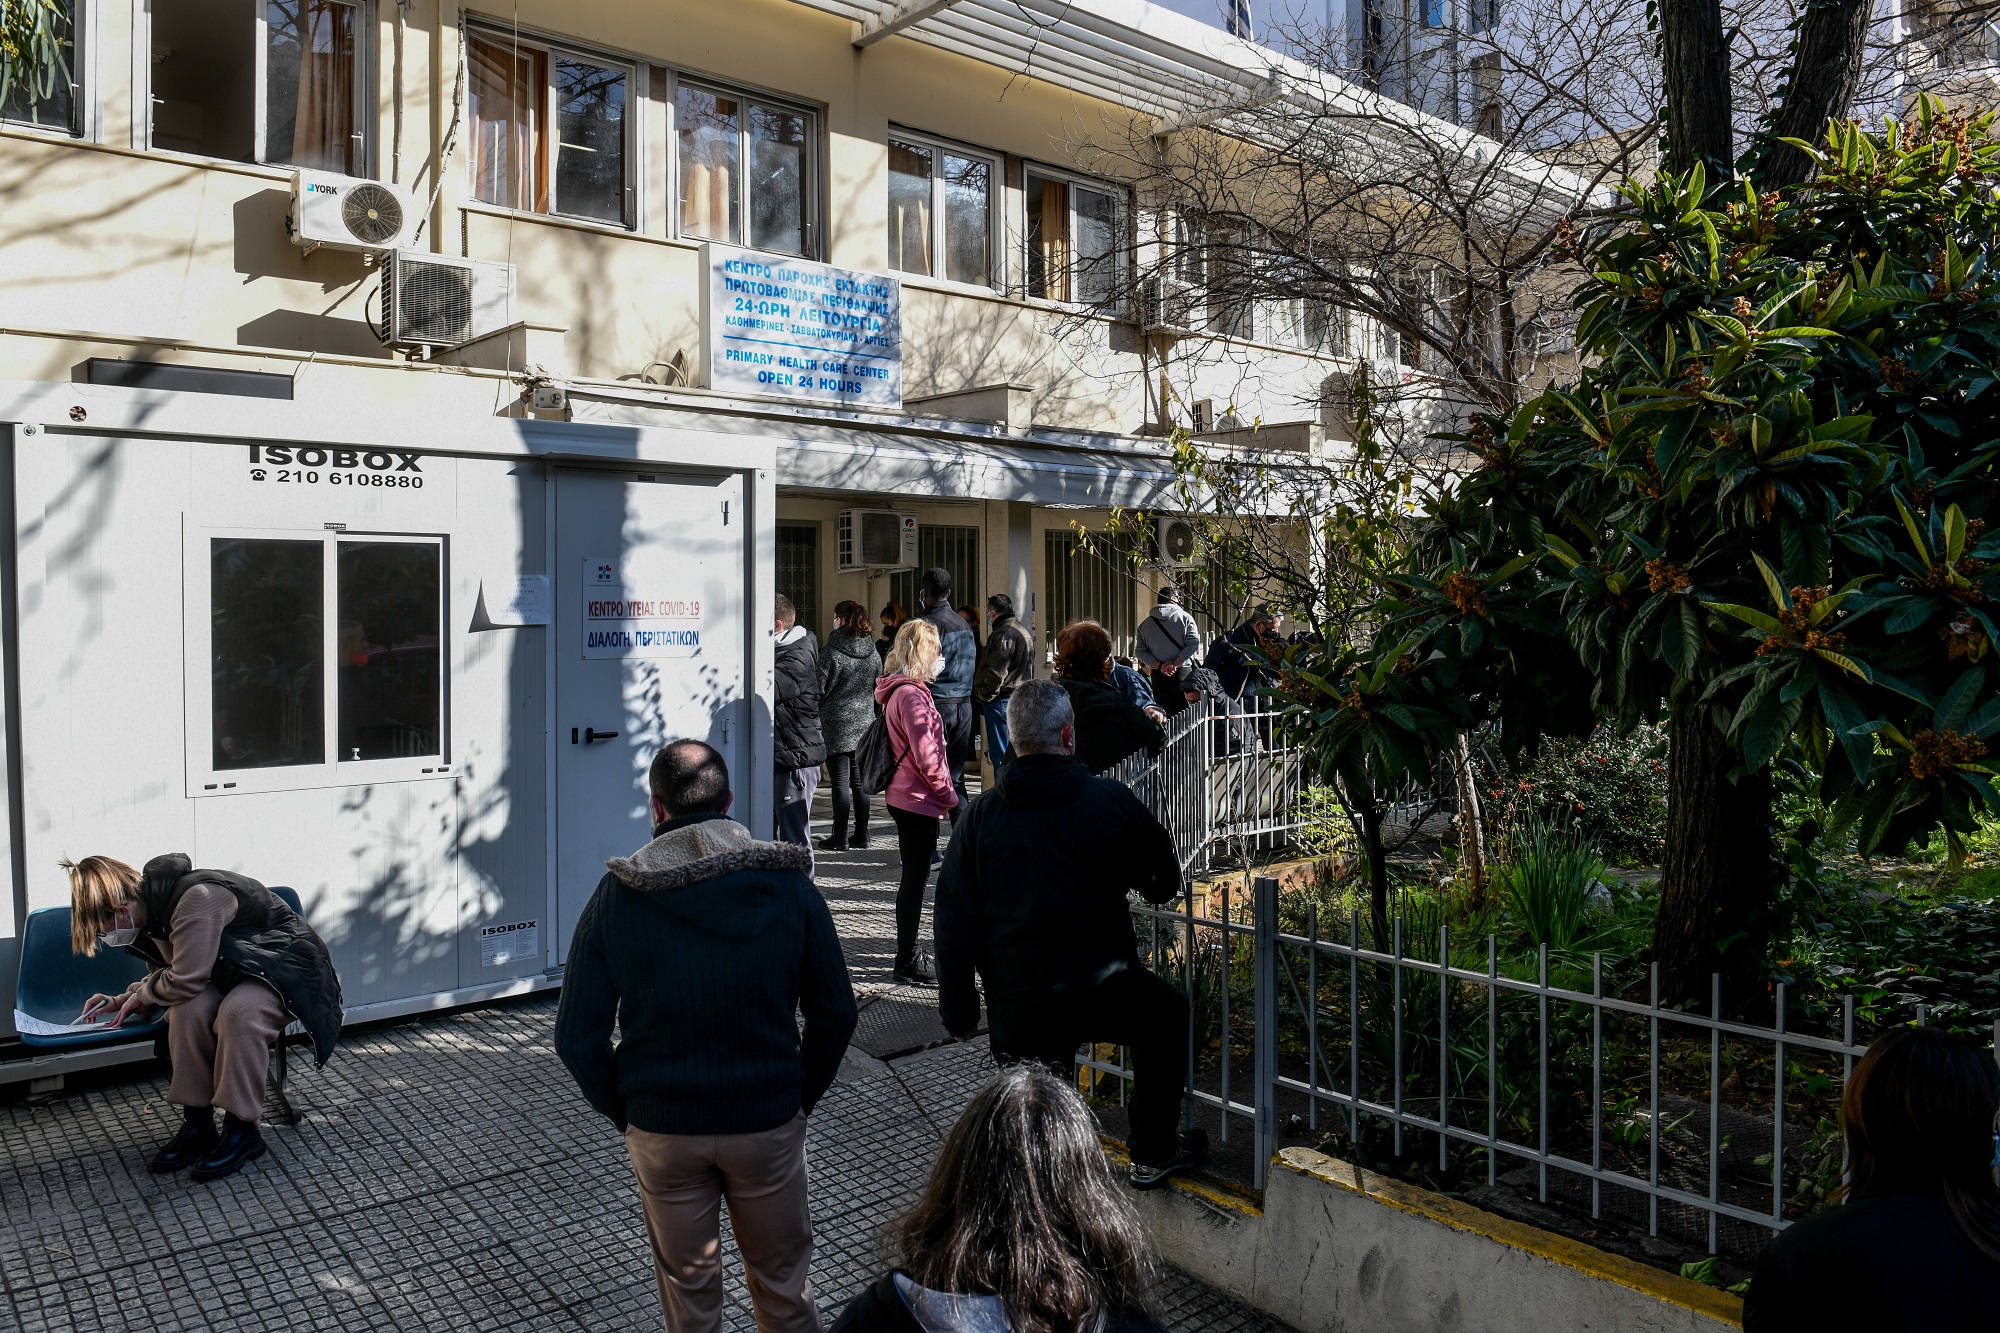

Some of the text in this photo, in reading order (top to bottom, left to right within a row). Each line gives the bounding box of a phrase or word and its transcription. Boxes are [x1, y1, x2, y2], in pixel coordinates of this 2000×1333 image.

[315, 184, 337, 195] YORK
[725, 260, 889, 298] ΚΕΝΤΡΟ ΠΑΡΟΧΗΣ ΕΚΤΑΚΤΗΣ
[725, 278, 889, 315] ΠΡΩΤΟΒΑΘΜΙΑΣ ΠΕΡΙΘΑΛΨΗΣ
[725, 316, 784, 332] ΚΑΘΗΜΕΡΙΝΕΣ
[791, 324, 858, 343] ΣΑΒΒΑΤΟΚΥΡΙΑΚΑ
[864, 335, 889, 347] ΑΡΓΙΕΣ
[799, 308, 881, 332] ΛΕΙΤΟΥΡΓΙΑ
[726, 349, 889, 380] PRIMARY HEALTH CARE CENTER
[758, 370, 862, 394] OPEN 24 HOURS
[249, 445, 423, 472] ISOBOX
[277, 470, 423, 488] 210 6108880
[588, 601, 700, 617] ΚΕΝΤΡΟ ΥΓΕΙΑΣ COVID-19
[588, 630, 699, 648] ΔΙΑΛΟΓΗ ΠΕΡΙΣΤΑΤΙΚΩΝ
[483, 921, 536, 935] ISOBOX
